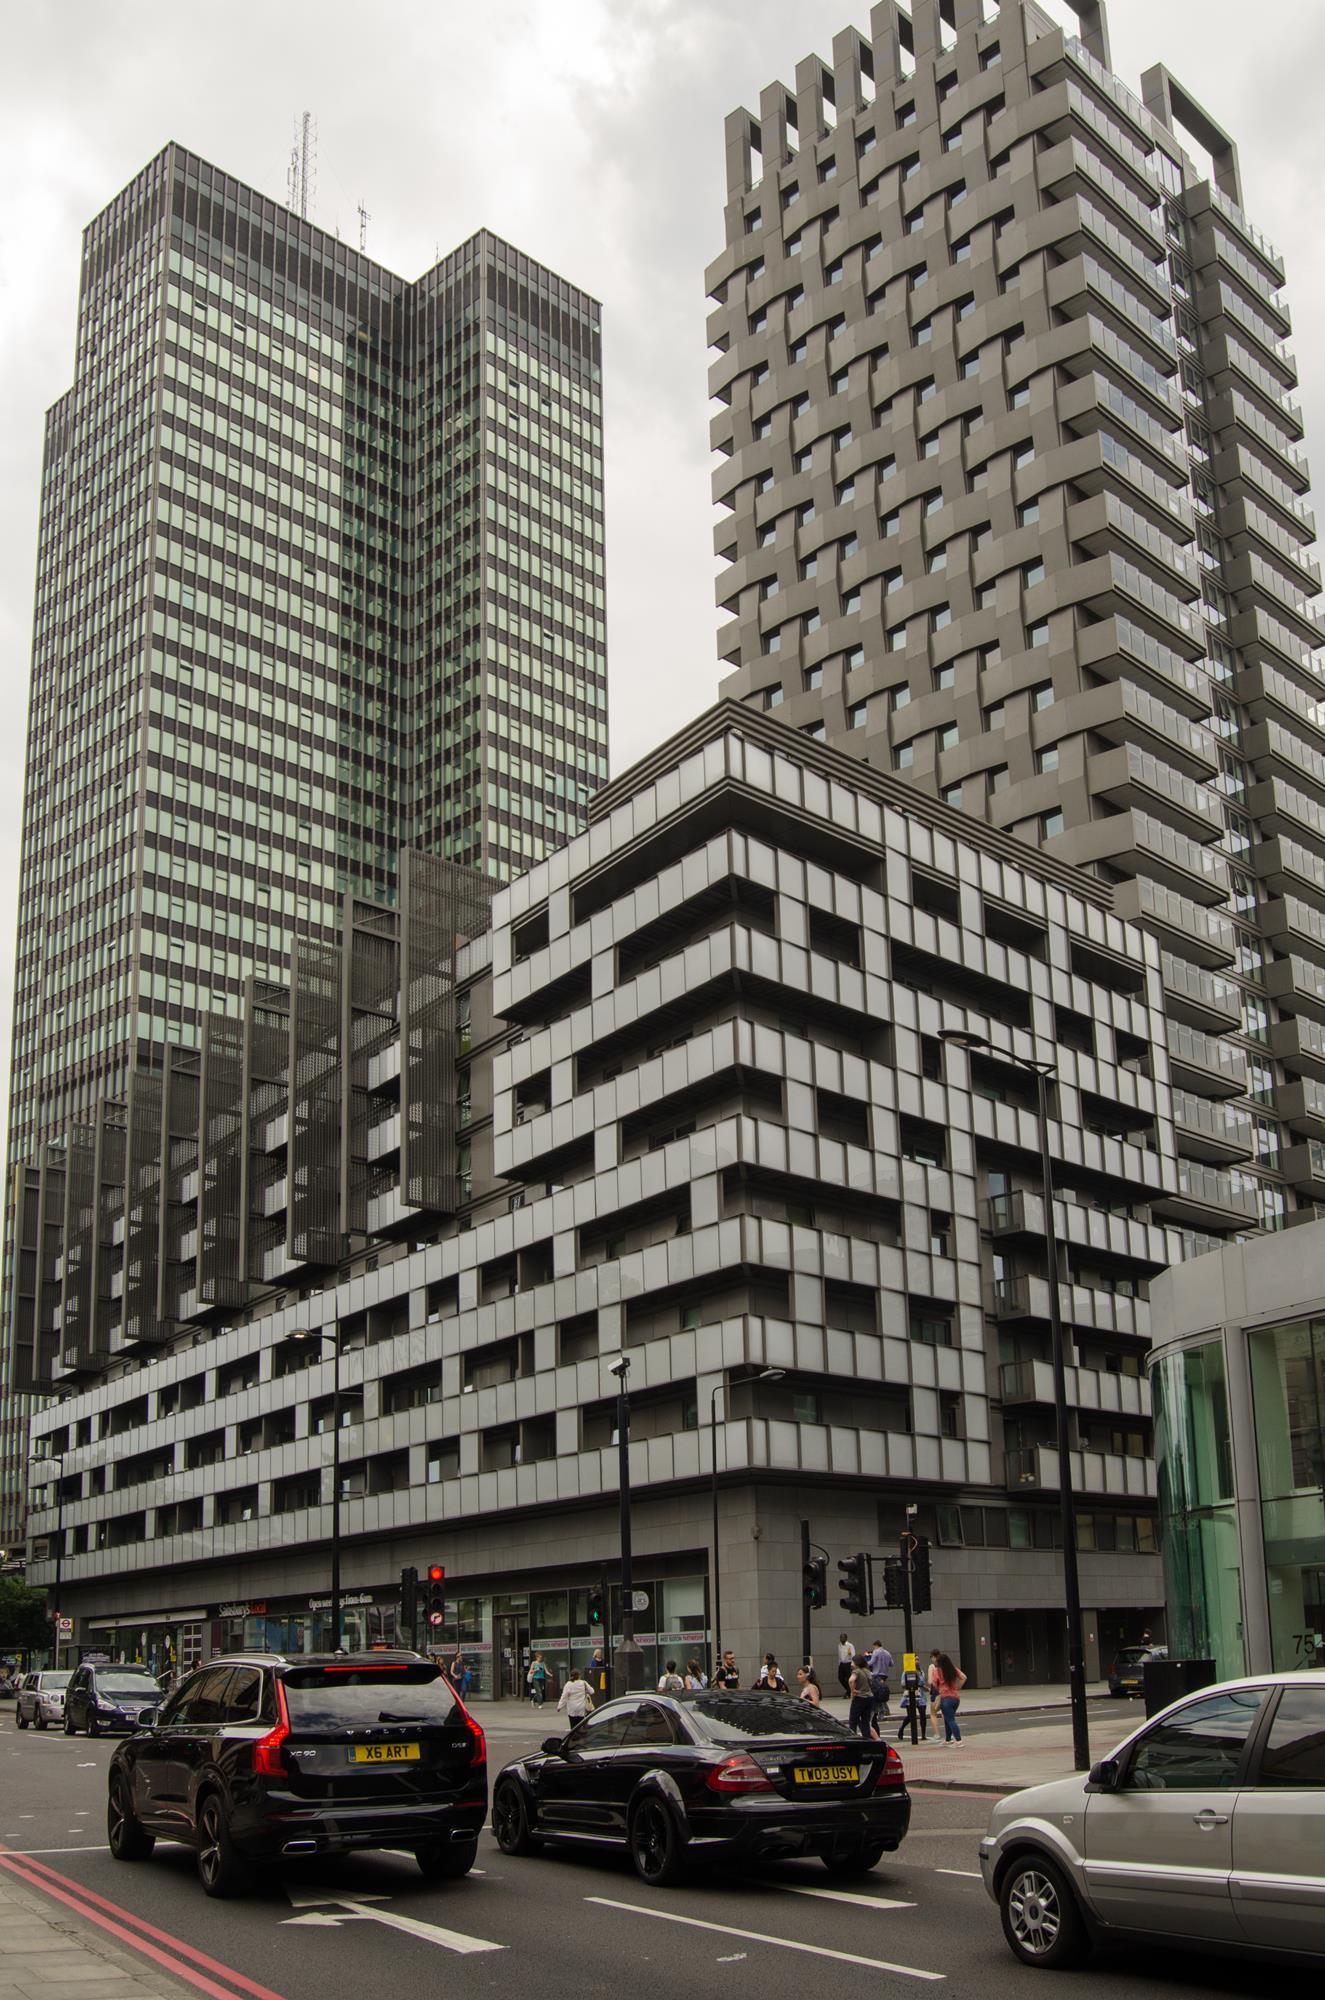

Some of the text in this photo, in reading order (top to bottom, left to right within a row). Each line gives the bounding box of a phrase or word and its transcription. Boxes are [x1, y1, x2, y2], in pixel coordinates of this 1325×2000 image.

[1292, 1634, 1314, 1655] 75
[366, 1745, 410, 1759] X6 ART
[800, 1767, 854, 1781] TW03 USY
